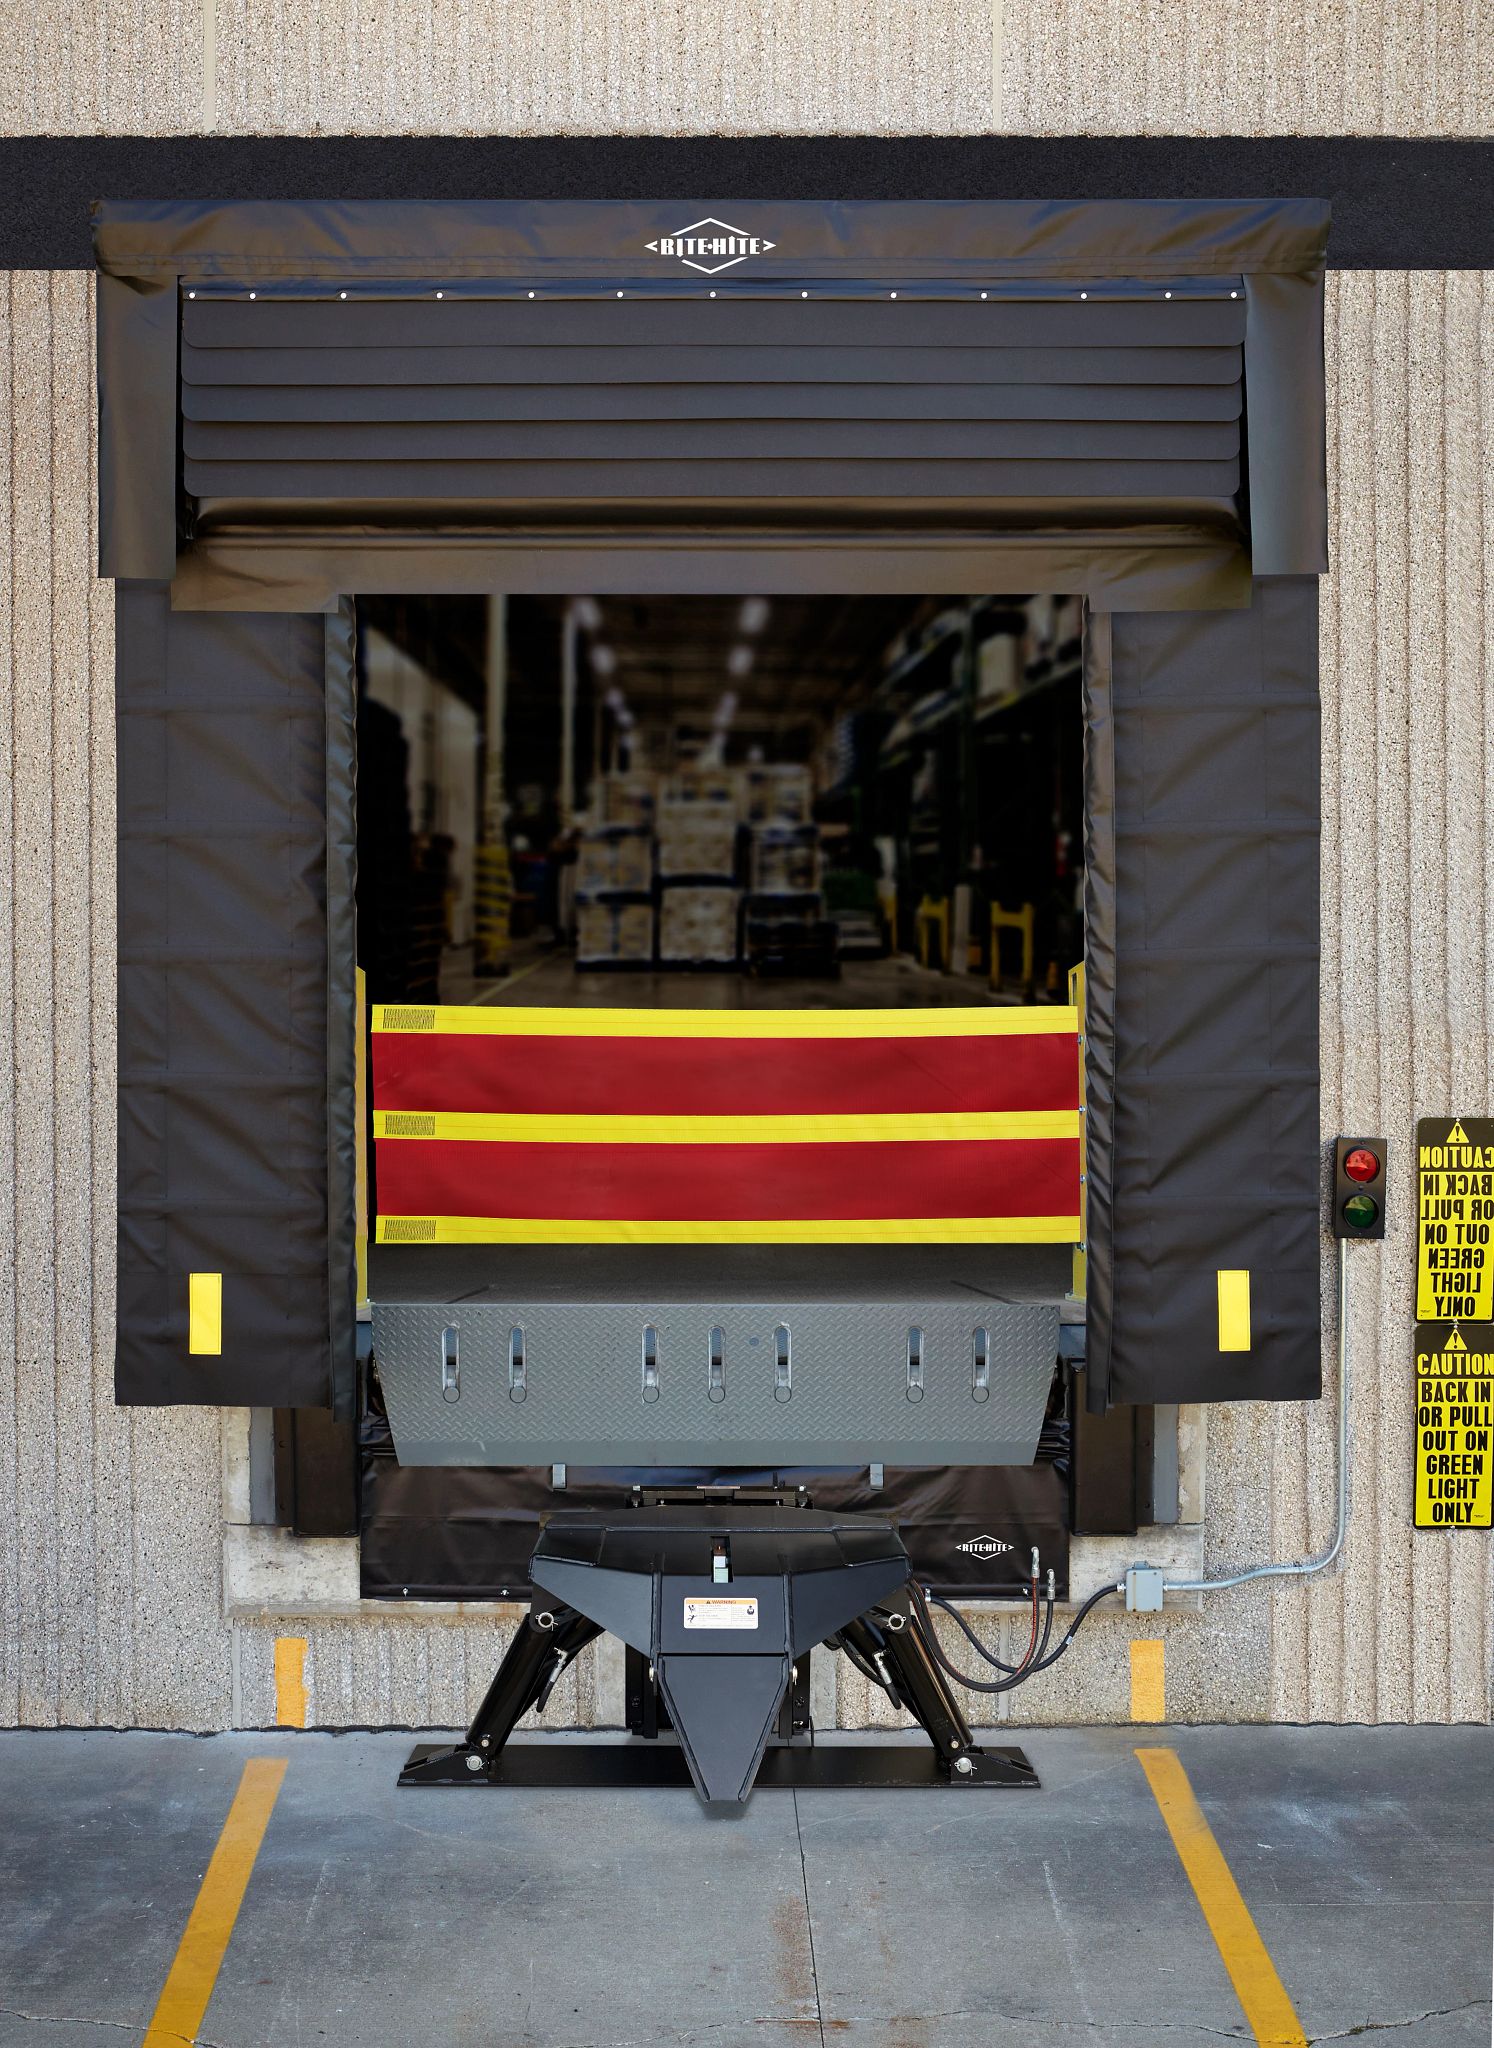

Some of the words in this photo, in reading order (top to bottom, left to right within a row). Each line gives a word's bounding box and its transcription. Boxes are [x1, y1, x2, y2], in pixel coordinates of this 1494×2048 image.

[1417, 1353, 1494, 1375] CAUTION
[1421, 1381, 1469, 1403] BACK
[1474, 1381, 1491, 1403] IN
[1418, 1406, 1443, 1427] OR
[1449, 1406, 1493, 1427] PULL
[1422, 1430, 1459, 1451] OUT
[1465, 1430, 1488, 1451] ON
[1426, 1454, 1483, 1475] GREEN
[1428, 1478, 1480, 1499] LIGHT
[1432, 1502, 1475, 1523] ONLY
